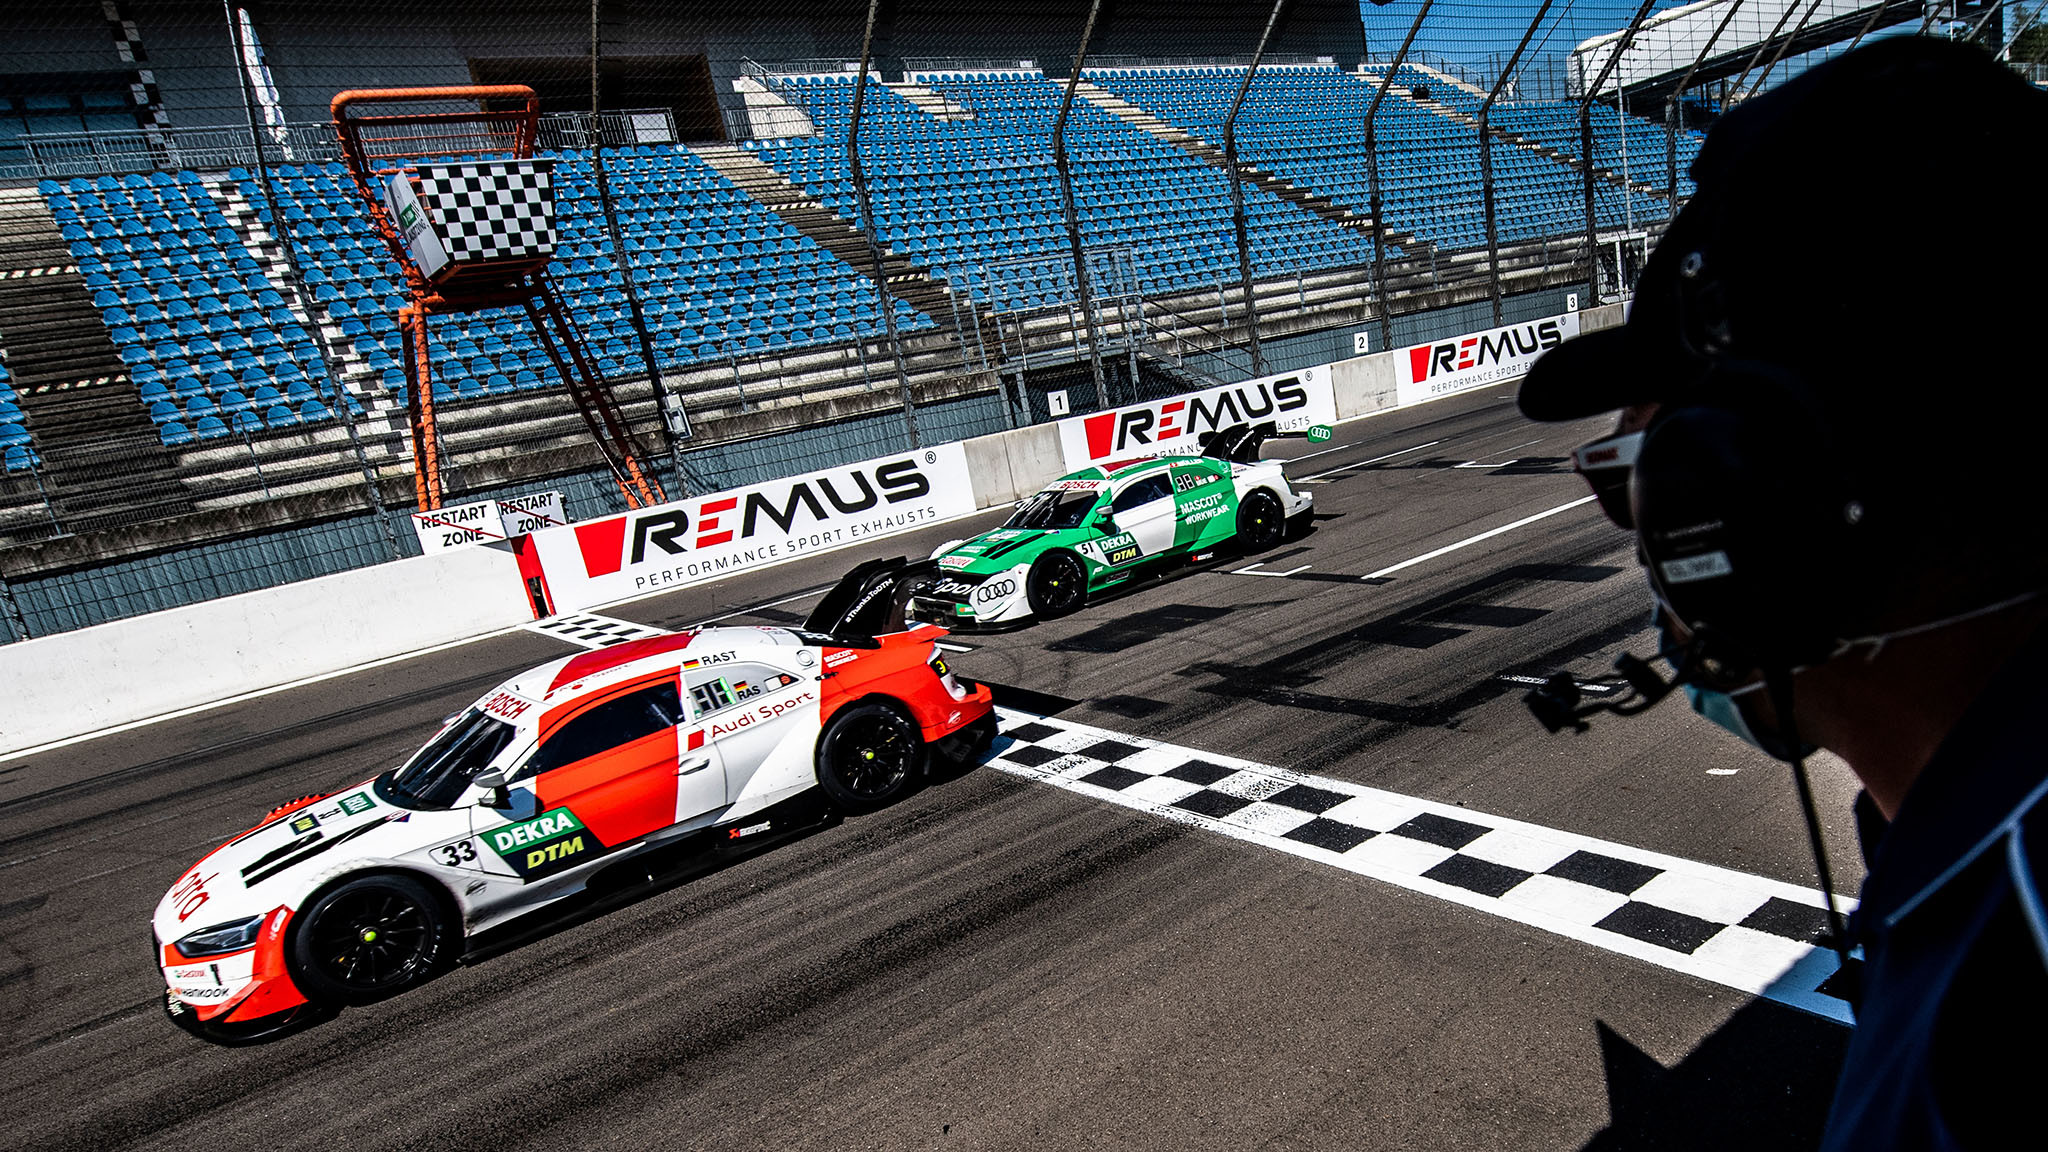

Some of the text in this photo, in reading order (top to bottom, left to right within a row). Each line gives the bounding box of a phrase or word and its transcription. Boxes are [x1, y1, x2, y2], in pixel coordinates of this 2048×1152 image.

[1569, 297, 1576, 308] 3
[1358, 336, 1365, 349] 2
[1431, 371, 1493, 393] PERFORMANCE
[1496, 363, 1522, 378] SPORT
[1054, 395, 1063, 411] 1
[1277, 415, 1311, 431] AUSTS
[1060, 481, 1100, 489] BOSCH
[501, 493, 553, 515] RESTART
[421, 505, 487, 529] RESTART
[518, 515, 551, 533] ZONE
[1185, 504, 1230, 525] WORKWEAR
[443, 527, 484, 547] ZONE
[1100, 533, 1133, 551] DEKRA
[635, 506, 936, 589] PERFORMANCE SPORT EXHAUSTS
[1081, 543, 1094, 555] 51
[1113, 547, 1136, 562] DTM
[844, 577, 893, 623] #ThanksToDTM
[701, 651, 737, 666] RAST
[737, 686, 761, 700] RAS
[485, 692, 531, 719] BOSCH
[712, 692, 814, 738] Audi Sport
[494, 812, 575, 851] DEKRA
[442, 841, 477, 867] 33
[527, 836, 584, 869] DTM
